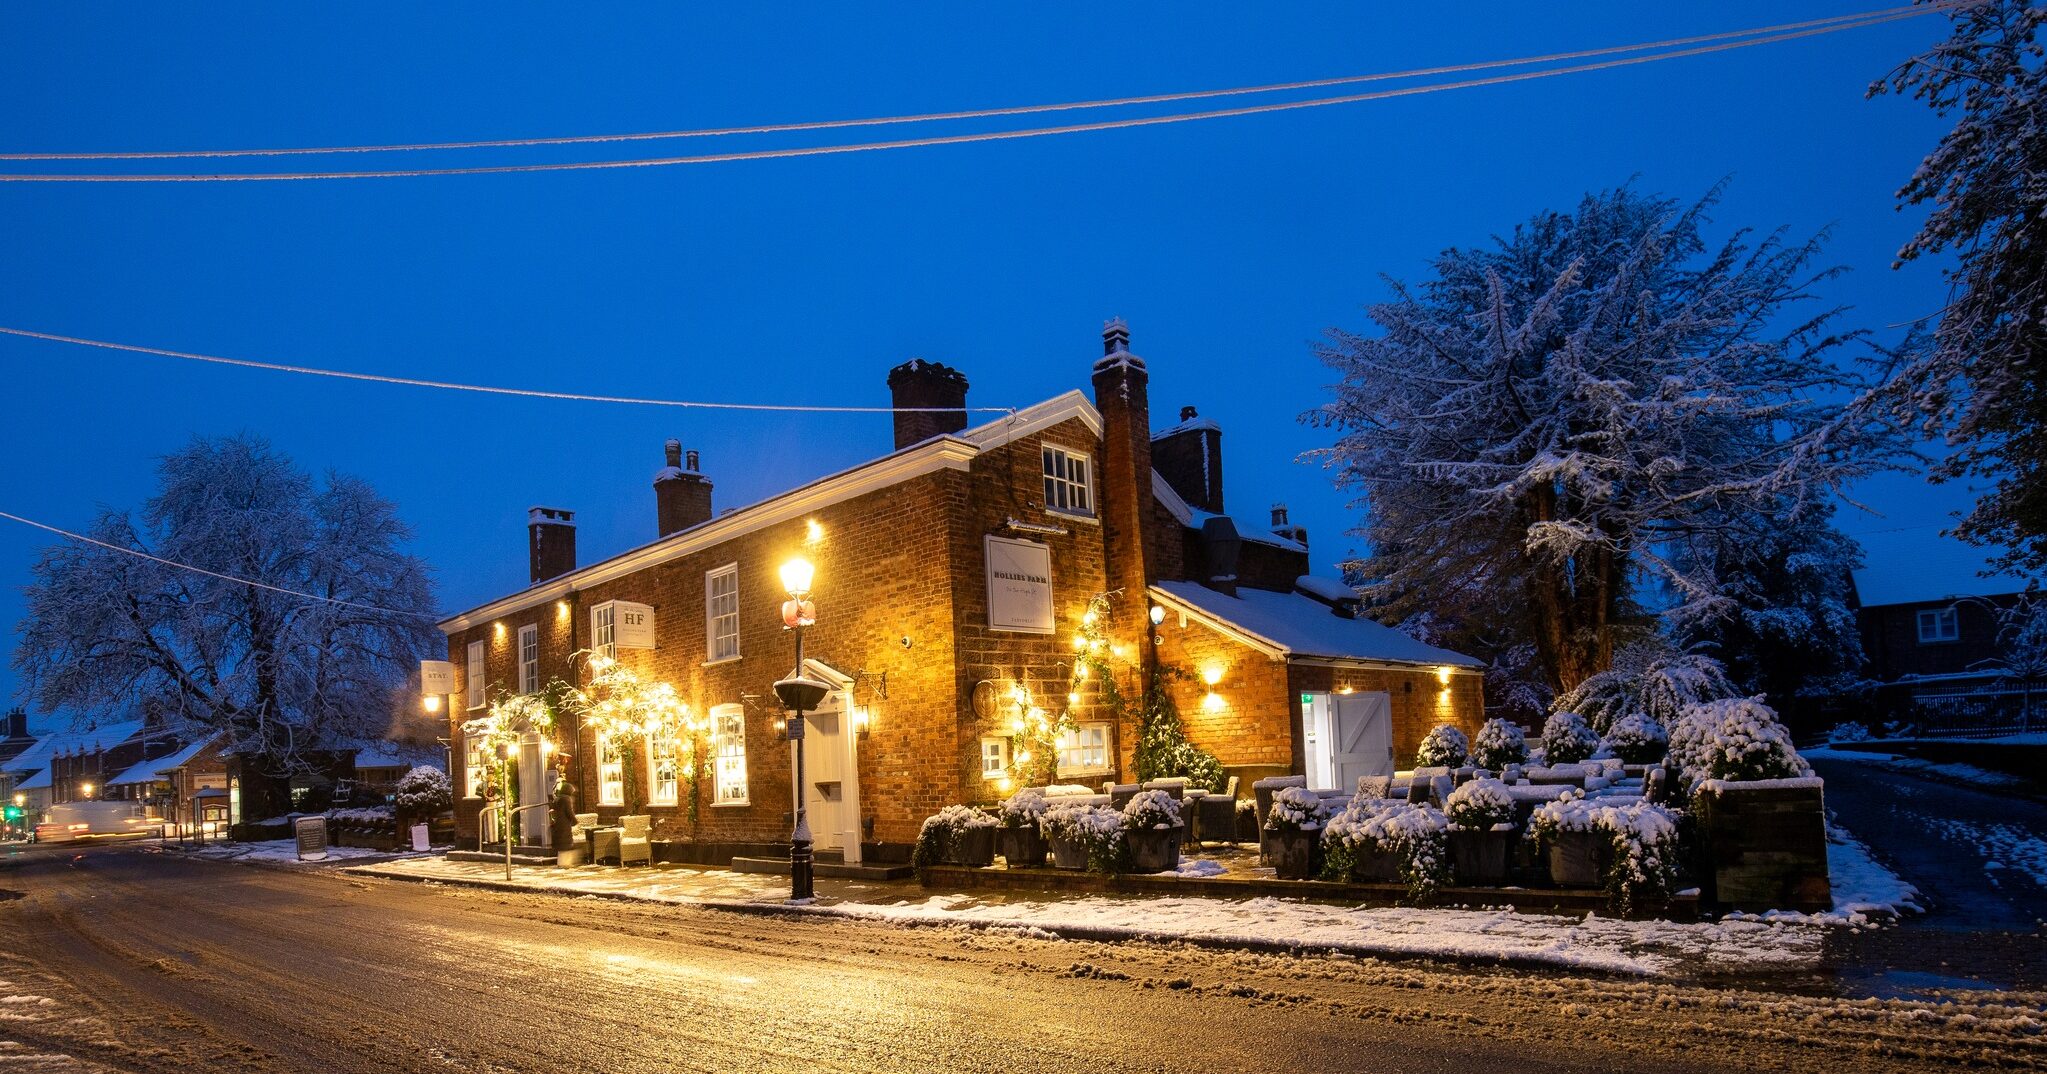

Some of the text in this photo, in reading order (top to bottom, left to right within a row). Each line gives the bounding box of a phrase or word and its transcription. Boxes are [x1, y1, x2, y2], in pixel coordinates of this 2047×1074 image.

[994, 571, 1047, 584] HOLLIES FARM
[624, 613, 645, 625] HF
